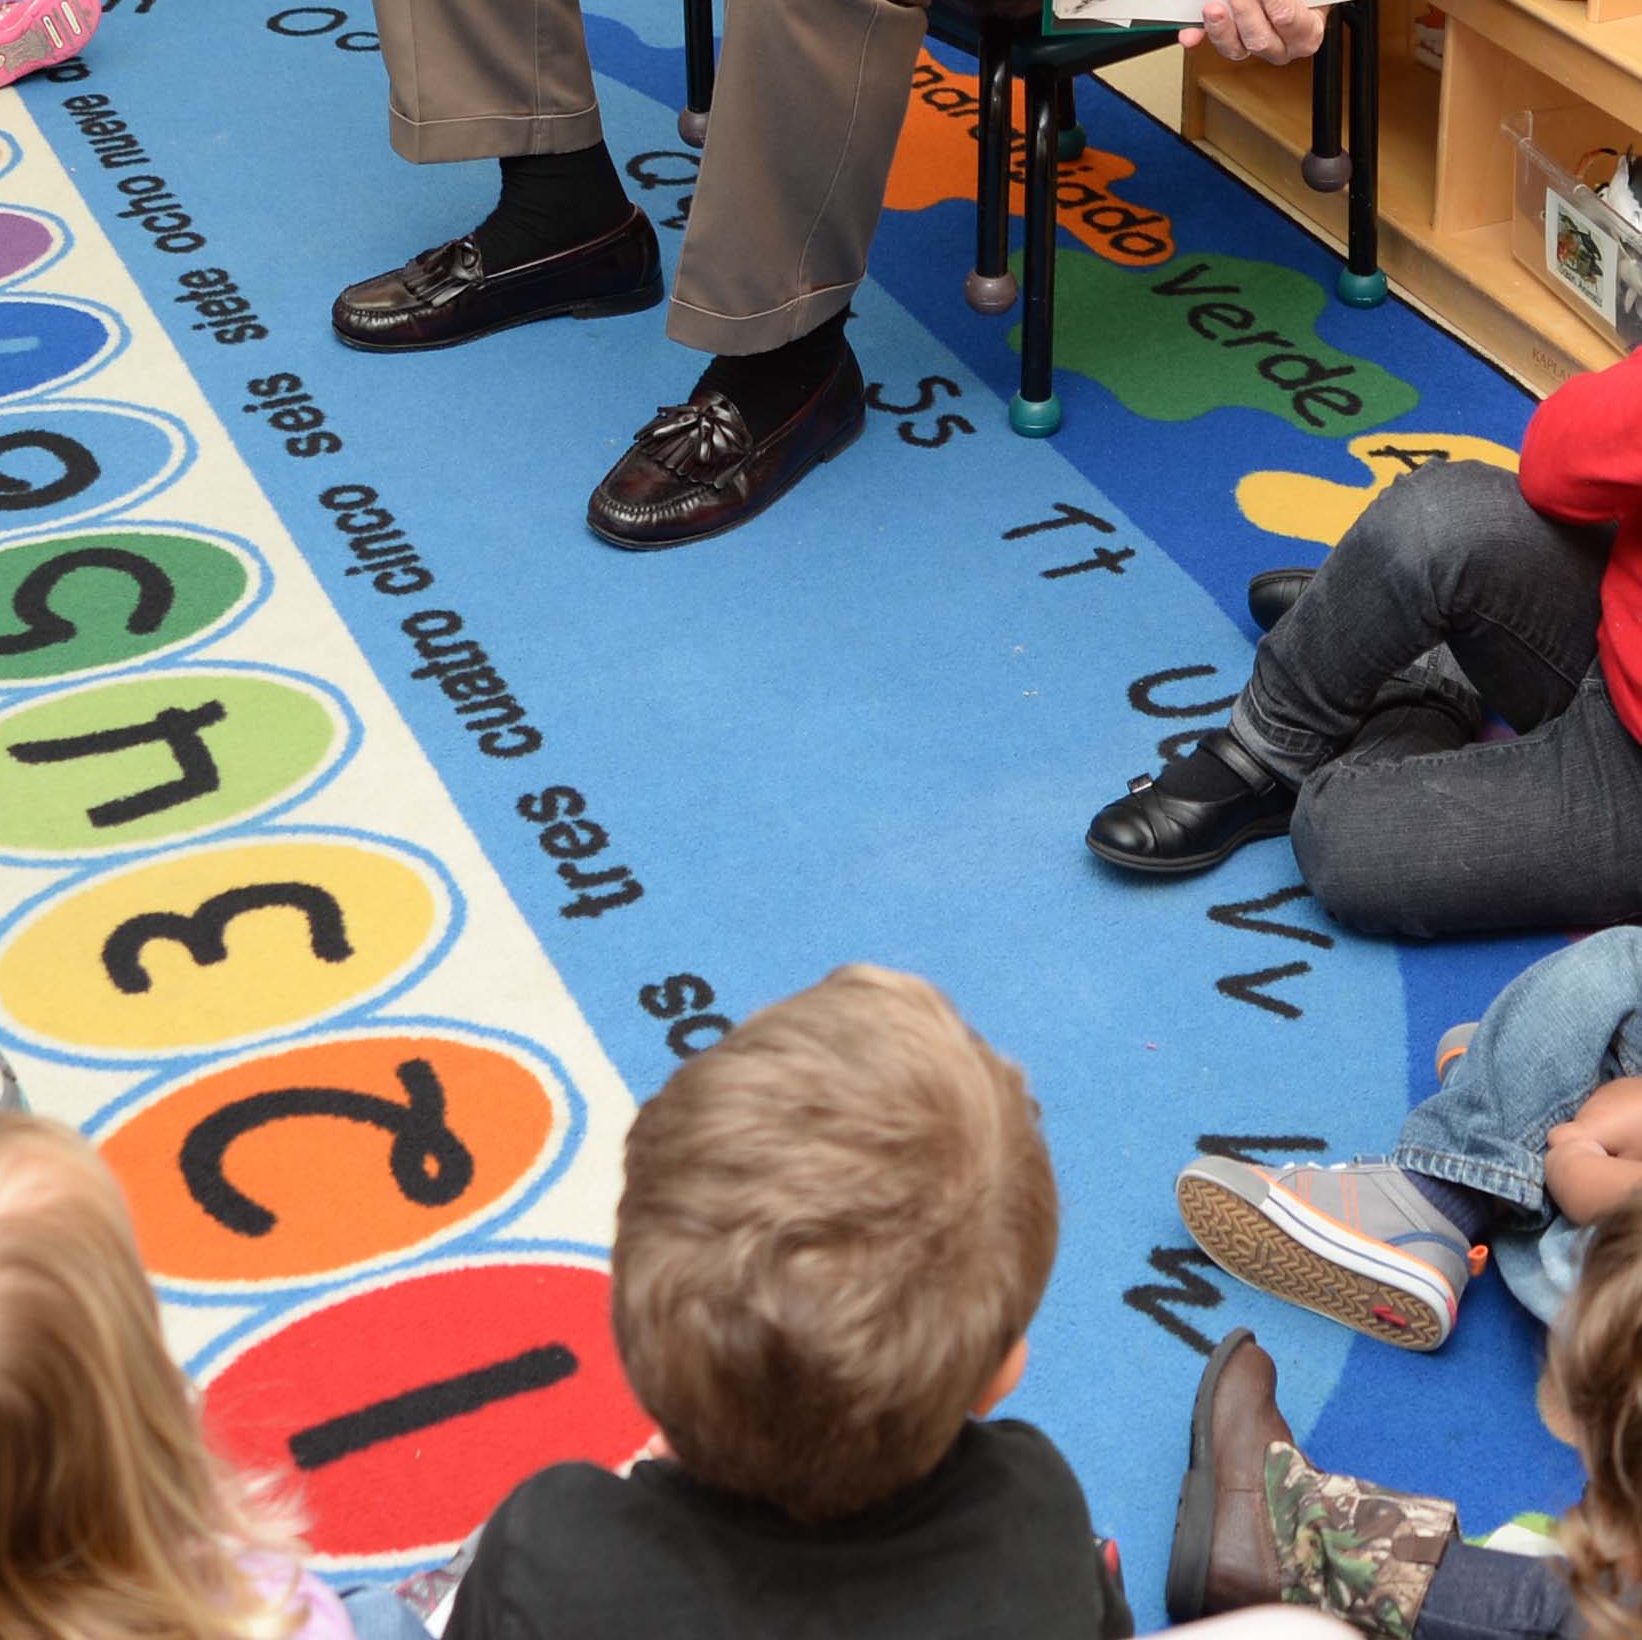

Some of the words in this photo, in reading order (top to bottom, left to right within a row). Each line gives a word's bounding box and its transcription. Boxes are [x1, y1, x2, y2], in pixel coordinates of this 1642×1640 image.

[60, 92, 151, 170] nueve
[116, 174, 208, 255] ocho
[173, 266, 269, 346] siete
[1150, 262, 1364, 429] Verde
[243, 370, 343, 459] seis
[864, 373, 978, 449] Ss
[318, 483, 436, 597] cinco
[1001, 502, 1136, 579] Tt
[400, 609, 544, 759] cuatro
[6, 700, 225, 828] 4
[517, 785, 645, 920] tres
[101, 882, 353, 994] 3
[1205, 884, 1336, 1020] Vv
[638, 972, 736, 1061] os
[179, 1058, 474, 1237] 2
[288, 1343, 579, 1471] 1
